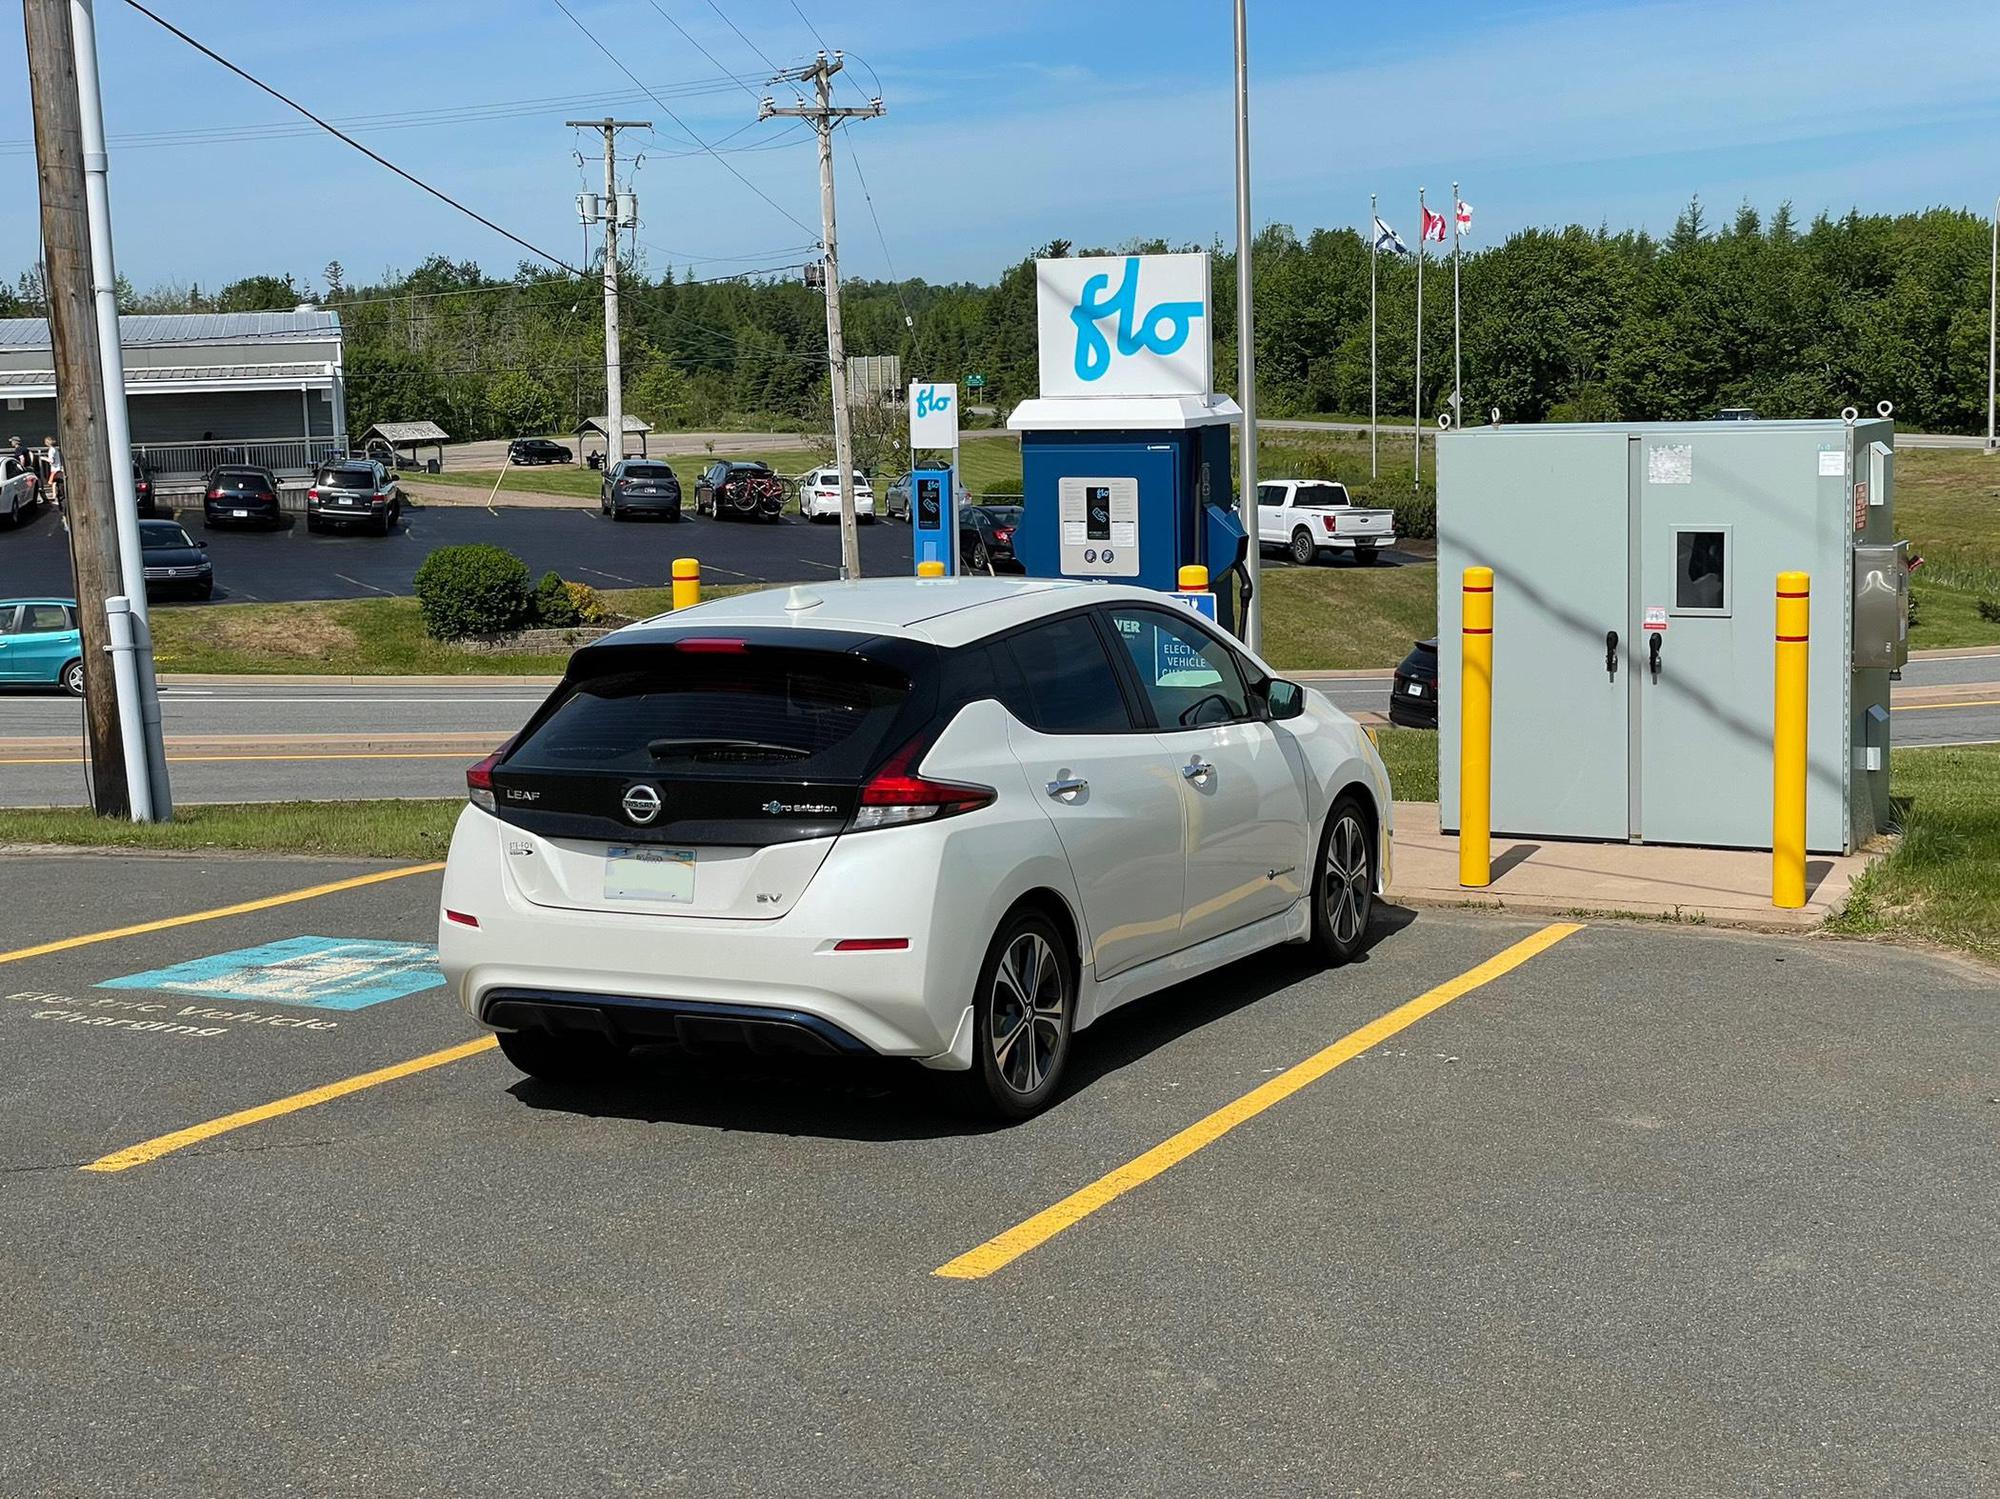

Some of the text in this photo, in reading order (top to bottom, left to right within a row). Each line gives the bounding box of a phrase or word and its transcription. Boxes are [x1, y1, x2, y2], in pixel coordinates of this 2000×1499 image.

[1070, 258, 1204, 382] flo
[916, 384, 950, 418] flo
[1167, 657, 1206, 668] VEHICLE
[506, 789, 541, 801] LEAF
[624, 800, 657, 809] NISSAN
[756, 893, 782, 903] SV
[5, 991, 338, 1030] Electric Vehicle
[31, 1010, 230, 1037] Charging
